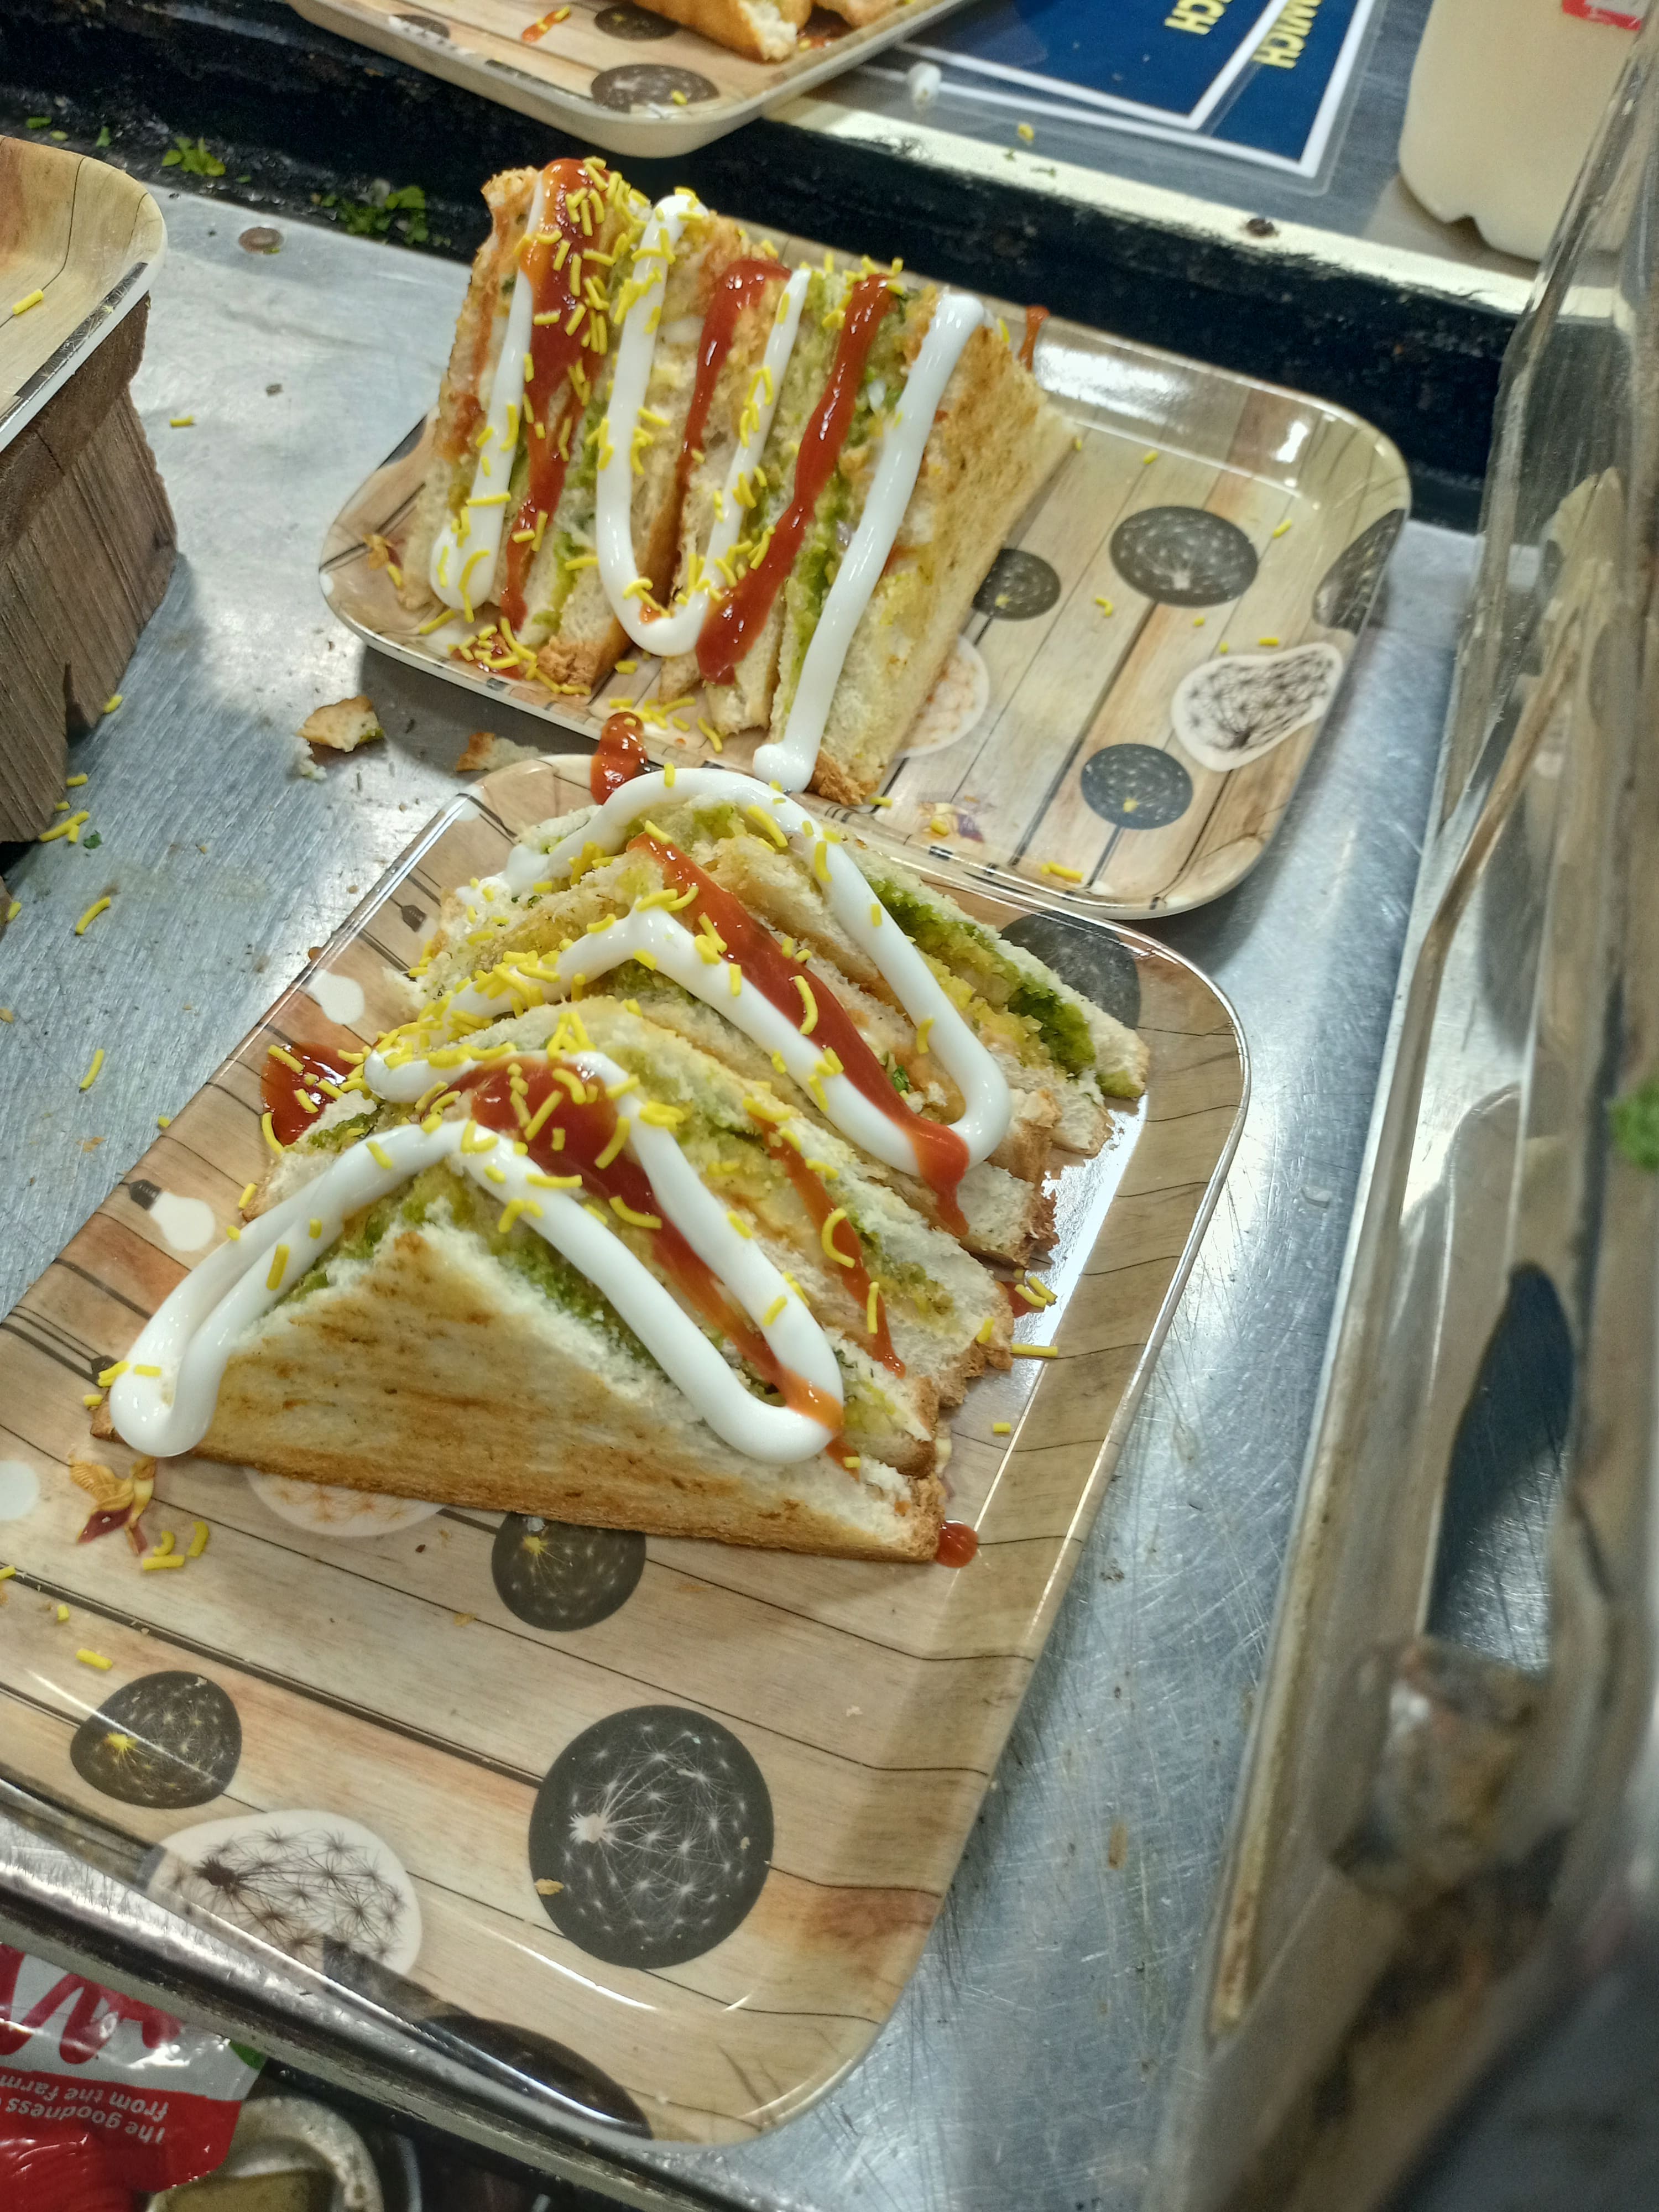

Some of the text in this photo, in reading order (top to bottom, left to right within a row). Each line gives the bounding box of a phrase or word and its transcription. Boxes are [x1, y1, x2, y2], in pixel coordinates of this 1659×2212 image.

[1164, 0, 1234, 35] CH
[0, 2074, 169, 2122] from the farm
[5, 2097, 166, 2145] The goodness
